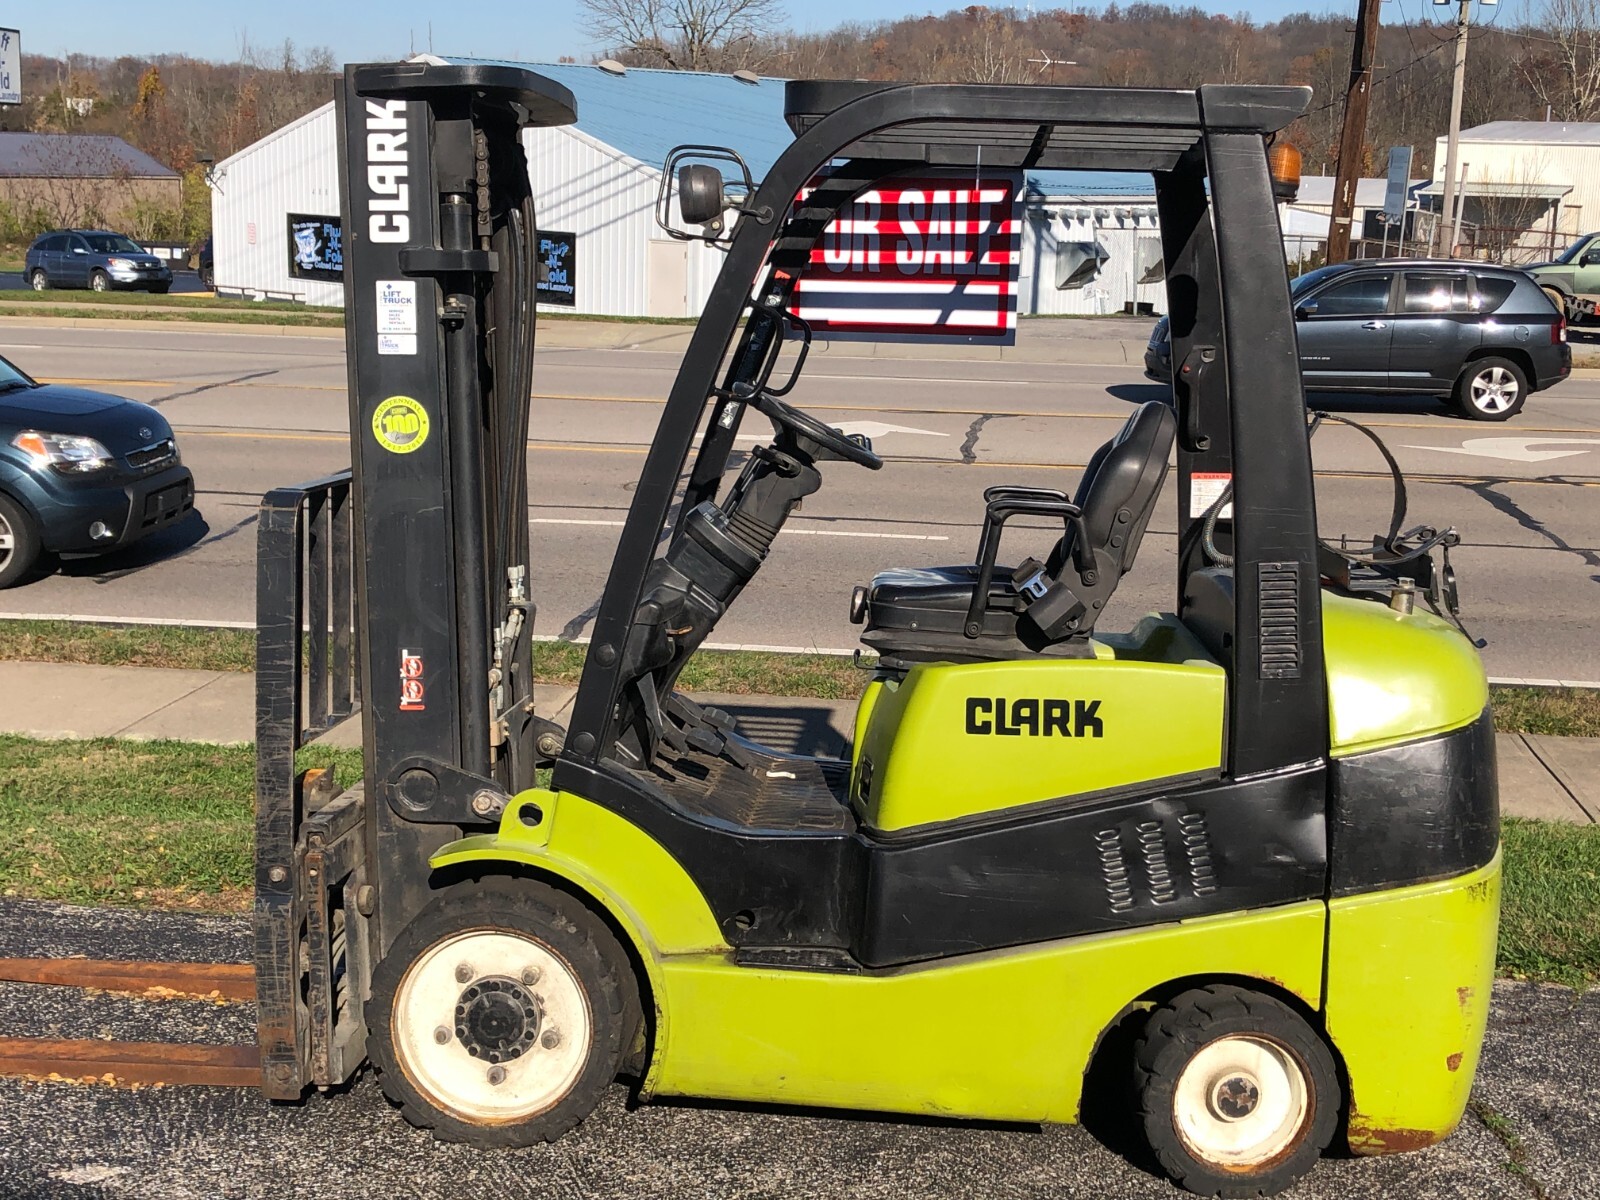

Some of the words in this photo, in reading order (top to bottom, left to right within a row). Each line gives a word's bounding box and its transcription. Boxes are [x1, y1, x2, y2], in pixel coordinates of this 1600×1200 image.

[366, 99, 410, 243] CLARK
[802, 187, 882, 273] OR
[895, 188, 1008, 275] SALE
[549, 269, 567, 283] old
[383, 297, 412, 305] TRUCK
[965, 697, 1104, 738] CLARK
